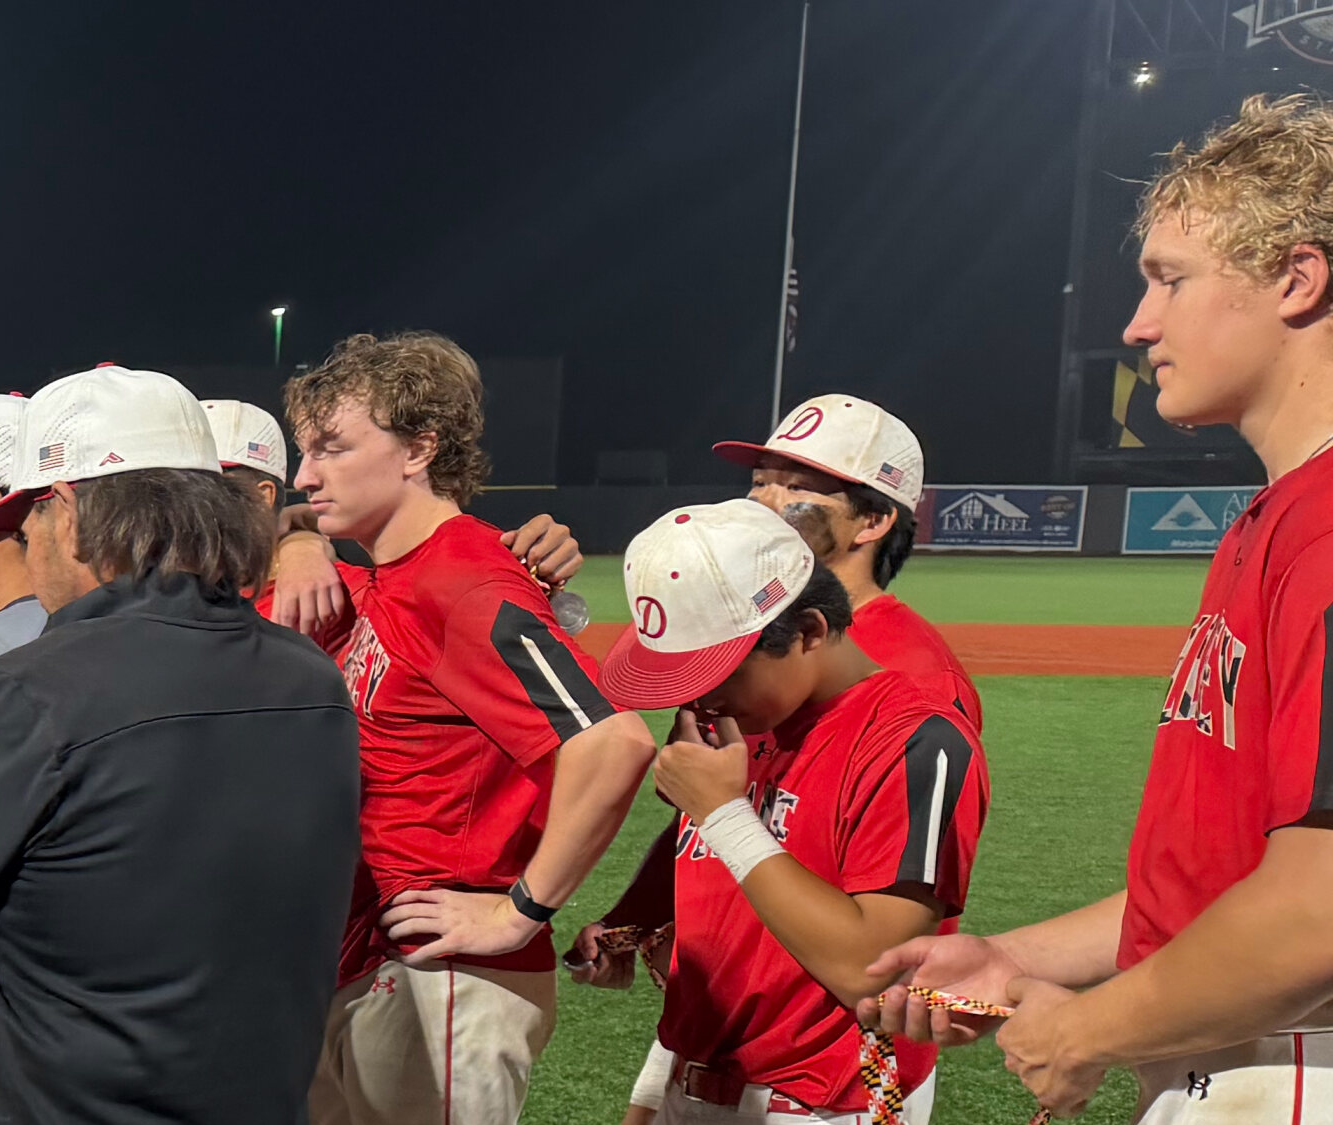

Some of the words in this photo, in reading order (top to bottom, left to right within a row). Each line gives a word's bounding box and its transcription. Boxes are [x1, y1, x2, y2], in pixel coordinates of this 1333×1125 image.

[776, 406, 824, 440] D
[942, 513, 974, 532] TAR
[982, 512, 1032, 532] HEEL
[635, 596, 667, 639] D
